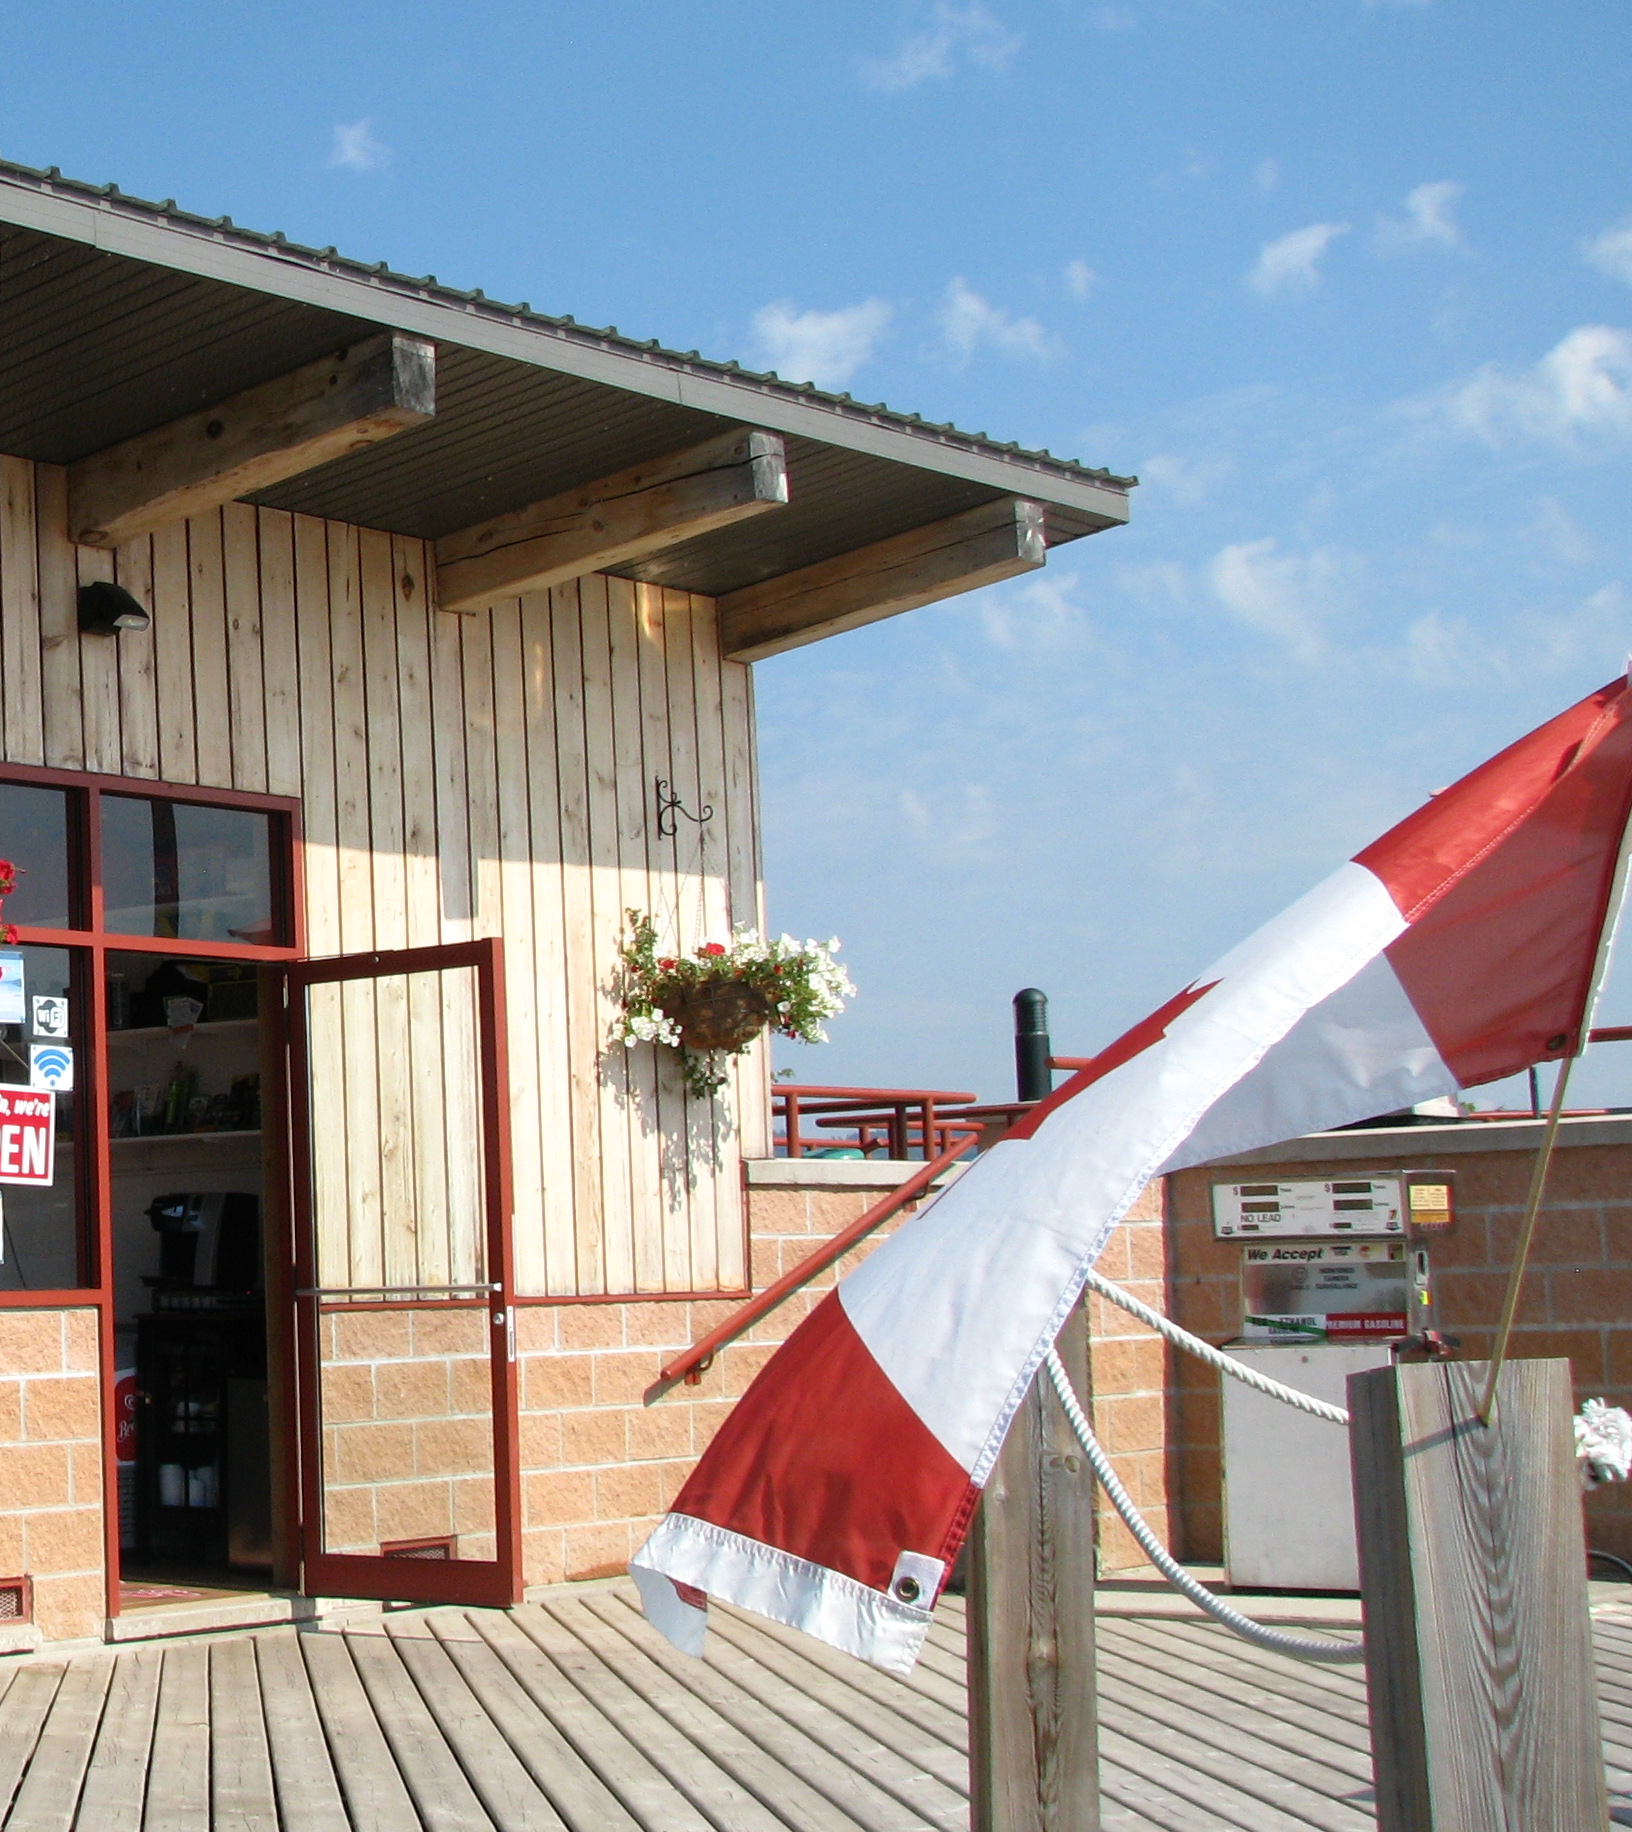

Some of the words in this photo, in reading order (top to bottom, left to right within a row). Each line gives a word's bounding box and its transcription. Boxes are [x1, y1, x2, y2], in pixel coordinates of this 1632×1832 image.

[14, 1098, 50, 1118] we're
[1240, 1214, 1254, 1222] NO
[1257, 1213, 1282, 1222] LEAD
[1248, 1250, 1267, 1260] We
[1272, 1248, 1323, 1261] Accept
